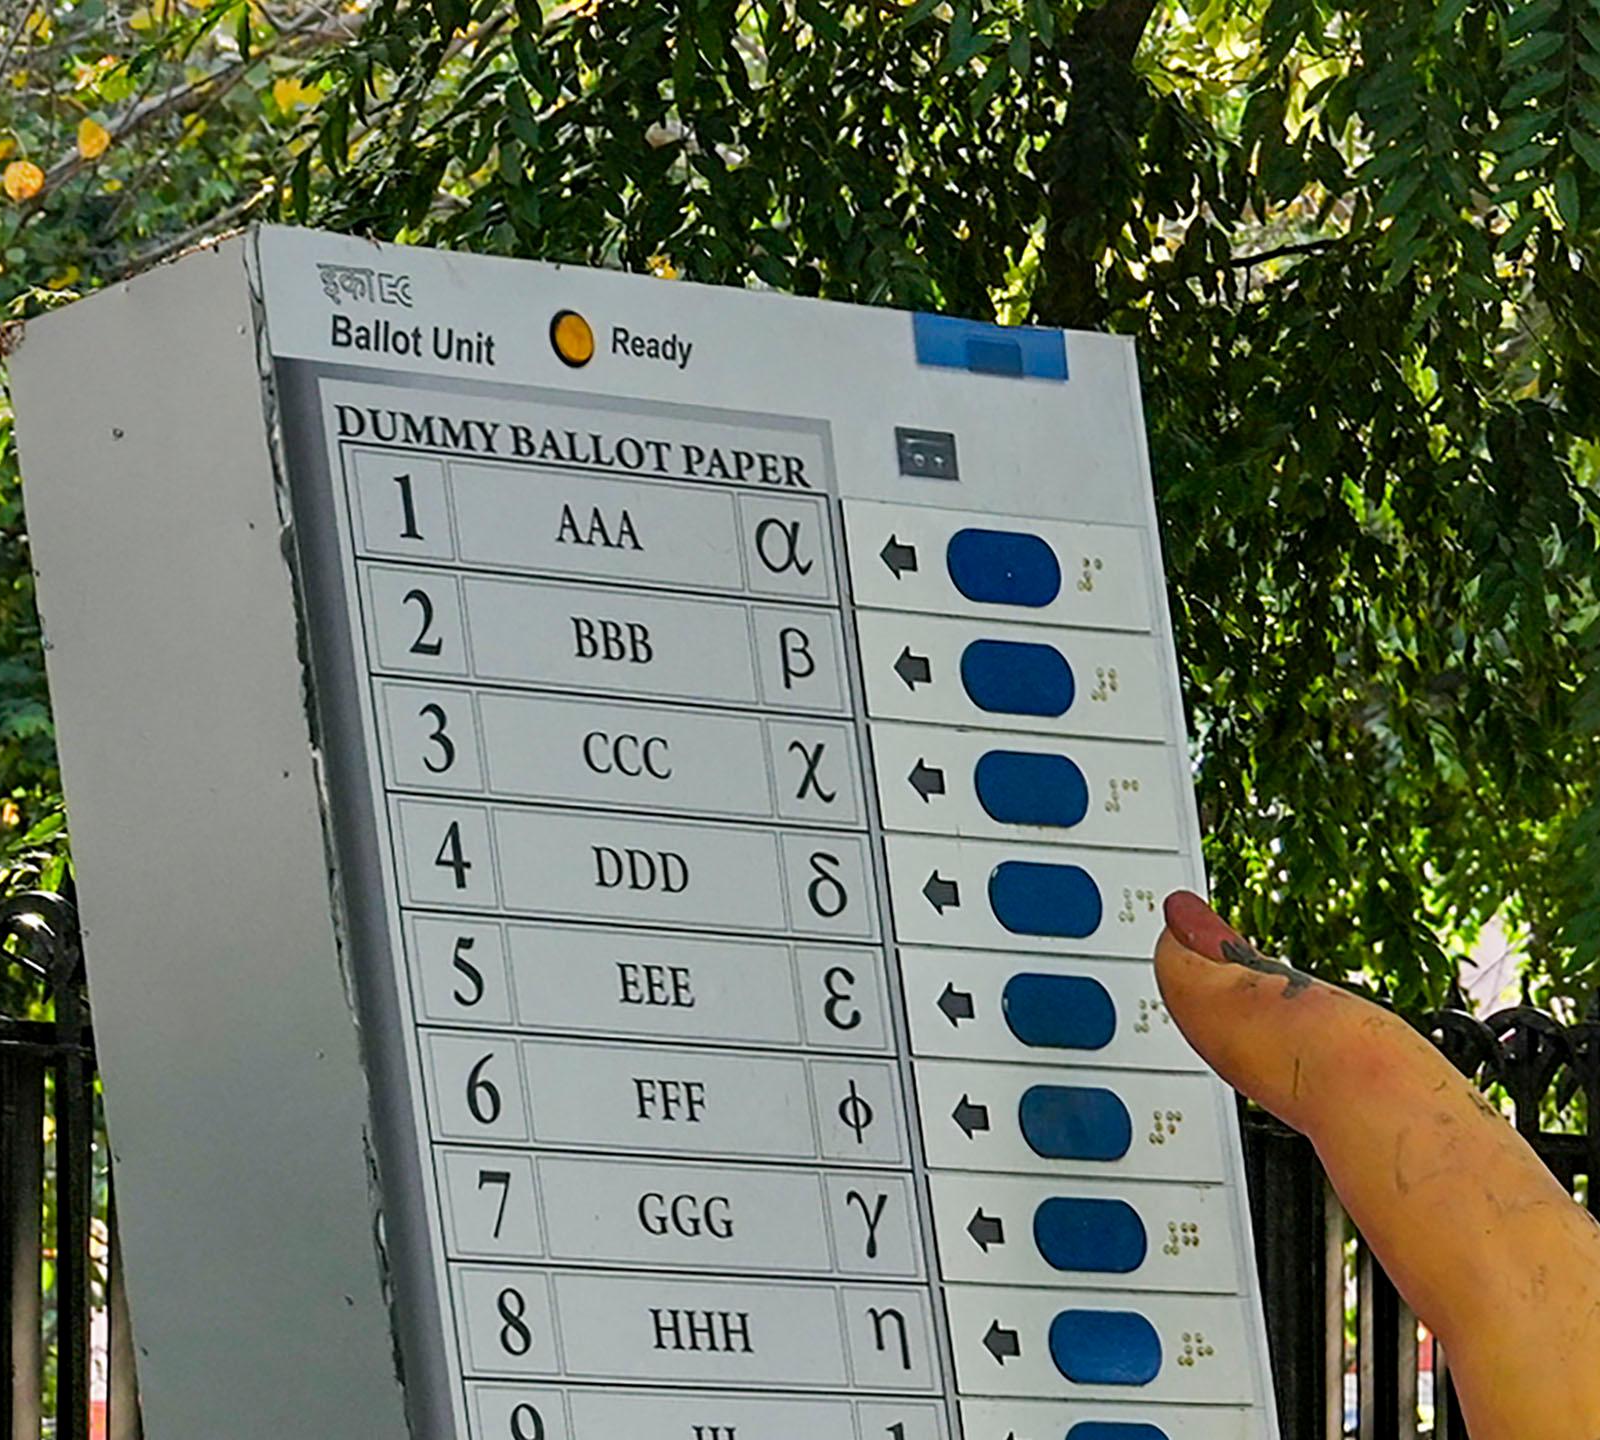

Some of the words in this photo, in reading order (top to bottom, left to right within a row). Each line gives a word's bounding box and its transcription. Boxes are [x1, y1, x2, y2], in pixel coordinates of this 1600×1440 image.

[332, 315, 421, 357] Ballot
[434, 327, 494, 365] Unit
[612, 327, 692, 369] Ready
[335, 405, 499, 454] DUMMY
[510, 425, 671, 473] BALLOT
[681, 444, 811, 488] PAPER
[394, 475, 424, 540] 1
[557, 504, 643, 550] AAA
[403, 590, 442, 655] 2
[571, 617, 652, 663] BBB
[420, 704, 454, 773] 3
[584, 732, 671, 779] CCC
[435, 821, 471, 888] 4
[592, 847, 688, 892] DDD
[454, 937, 483, 1006] 5
[617, 963, 694, 1007] EEE
[467, 1054, 500, 1124] 6
[633, 1079, 704, 1122] FFF
[479, 1170, 510, 1238] 7
[639, 1193, 733, 1238] GGG
[498, 1288, 531, 1356] 8
[650, 1309, 753, 1352] HHH
